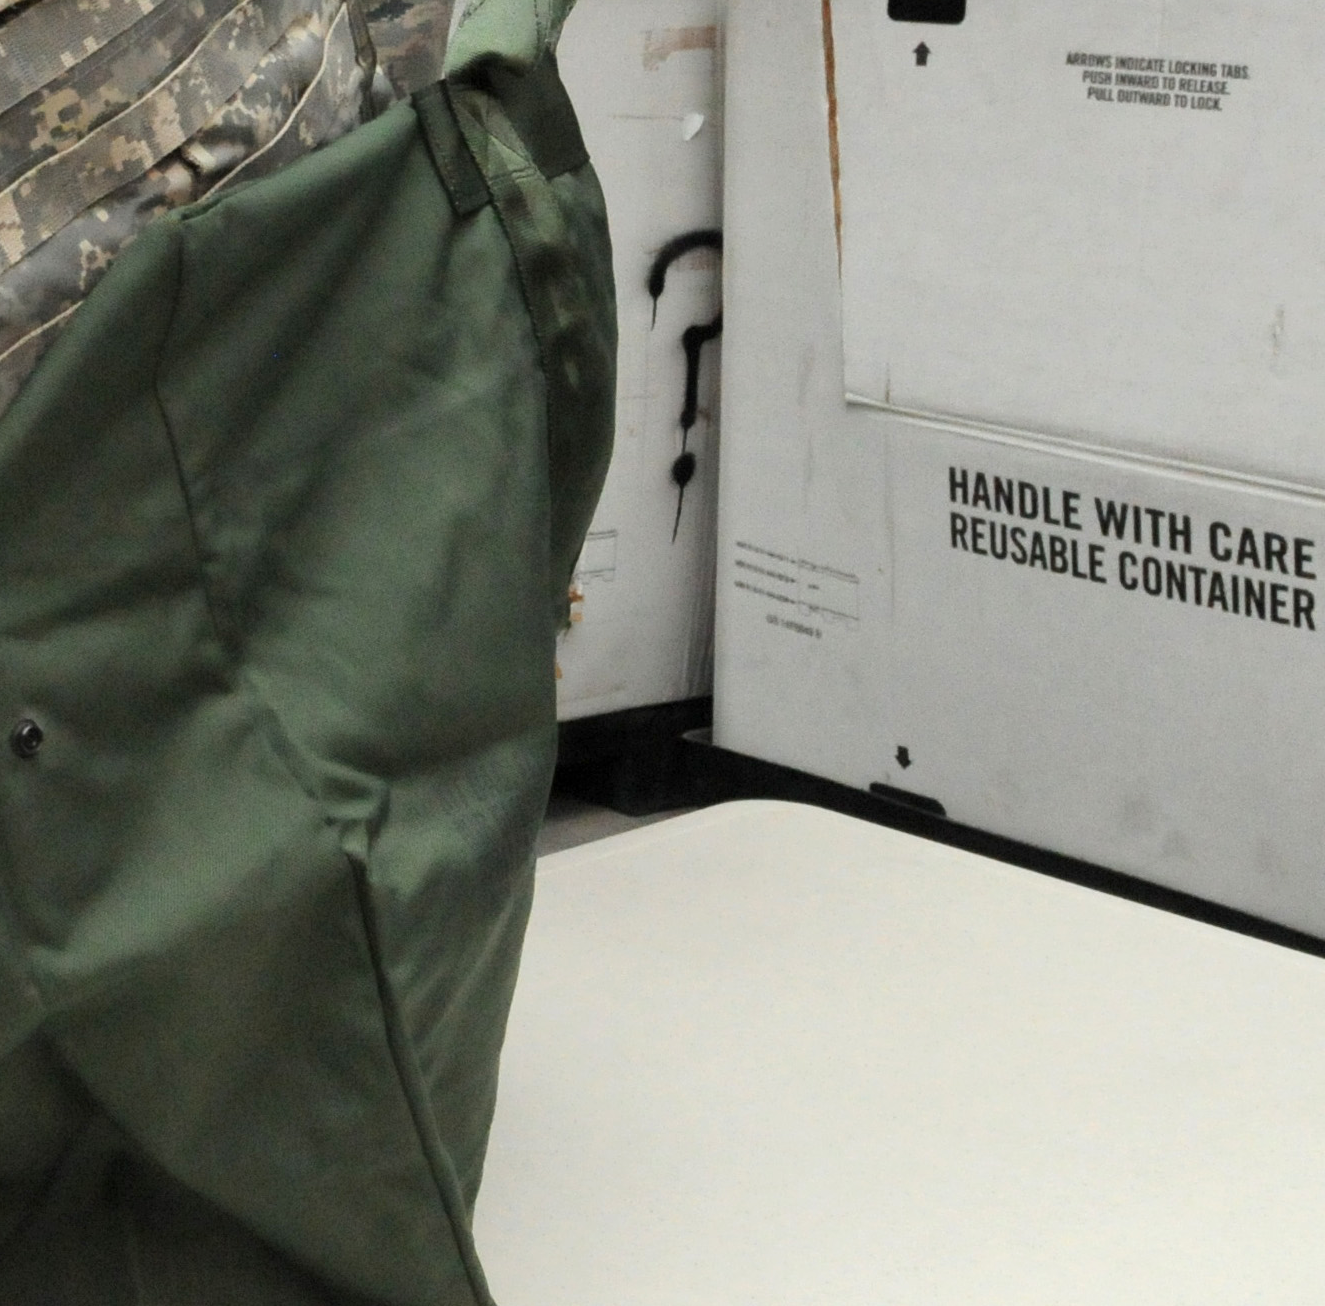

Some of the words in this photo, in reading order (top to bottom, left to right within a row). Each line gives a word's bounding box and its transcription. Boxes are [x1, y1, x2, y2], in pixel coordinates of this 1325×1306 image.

[1065, 51, 1112, 68] ARROWS
[1115, 55, 1165, 73] INDICATE
[1168, 59, 1217, 77] LOCKING
[1082, 69, 1112, 85] PUSH
[1115, 72, 1159, 89] INWARD
[1162, 76, 1176, 91] TO
[1087, 85, 1115, 102] PULL
[1117, 88, 1171, 107] OUTWARD
[1174, 93, 1188, 108] TO
[948, 466, 1083, 531] HANDLE
[1094, 496, 1193, 555] WITH
[1208, 520, 1317, 581] CARE
[950, 511, 1108, 584] REUSABLE
[1118, 550, 1317, 632] CONTAINER
